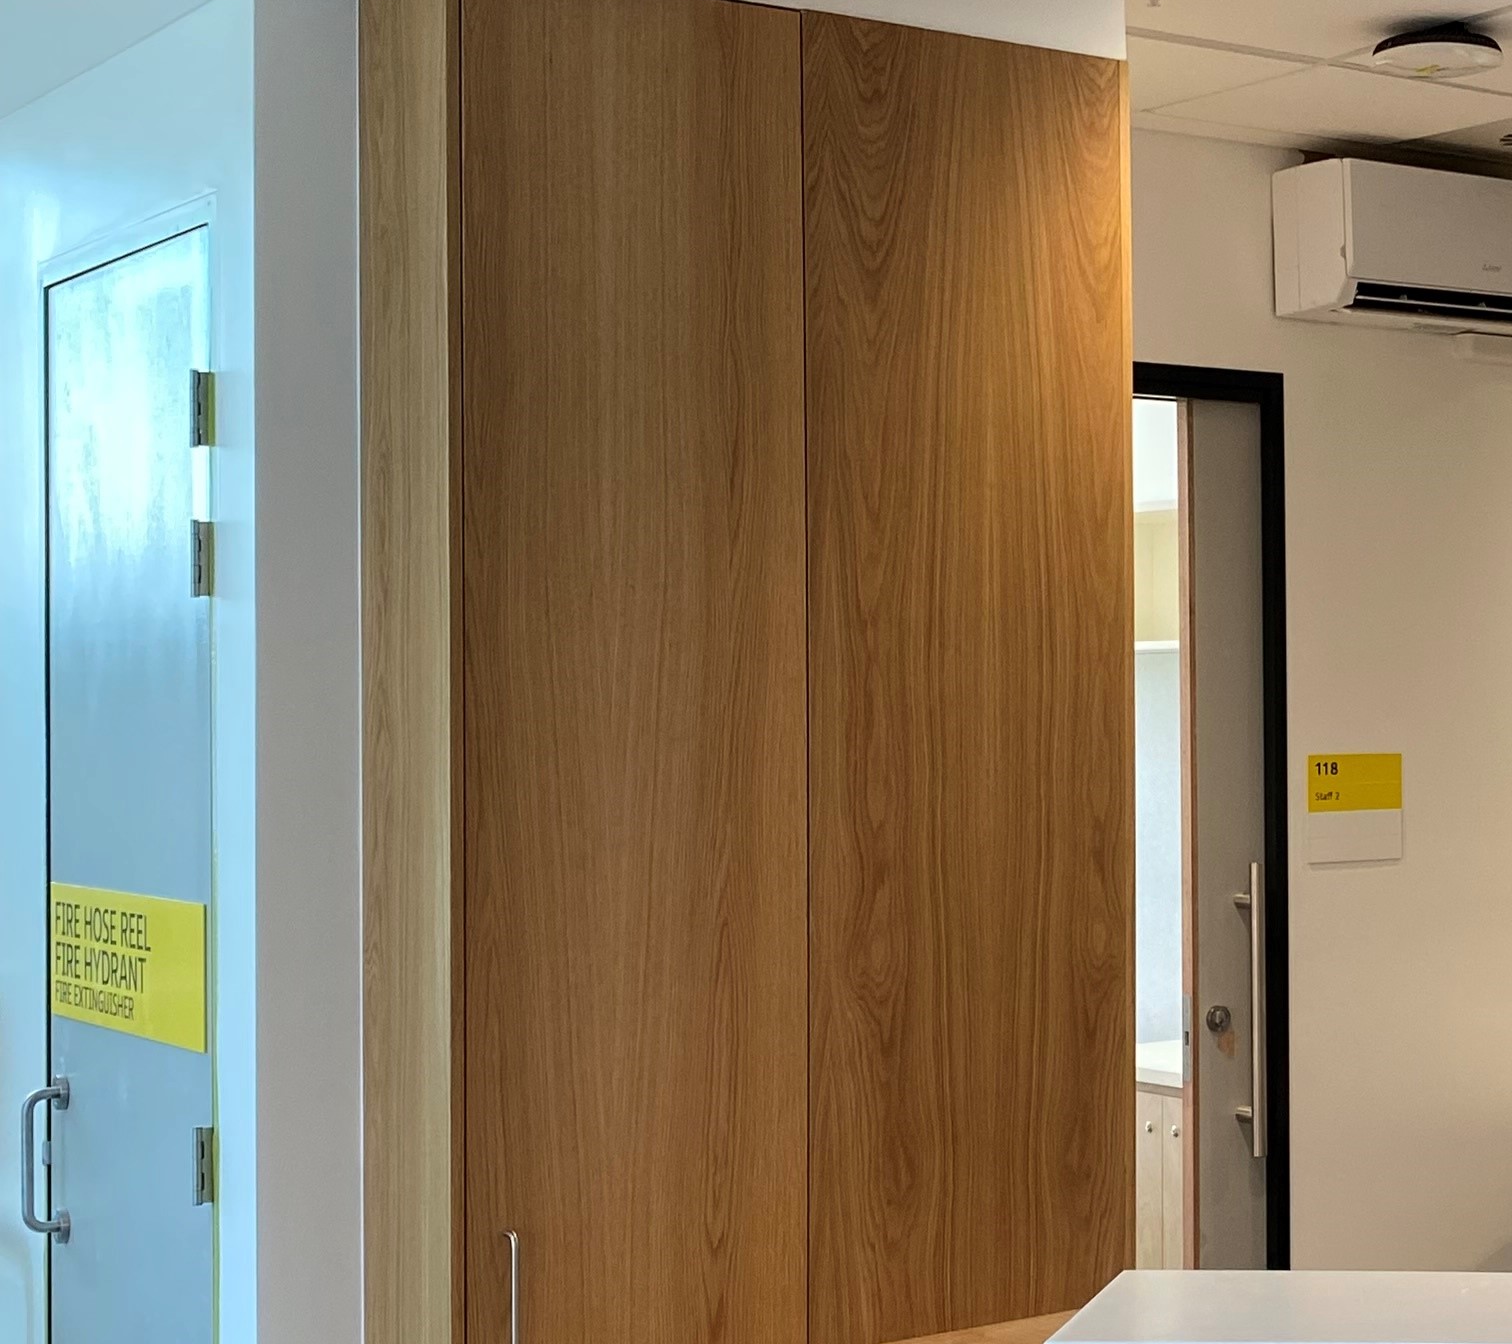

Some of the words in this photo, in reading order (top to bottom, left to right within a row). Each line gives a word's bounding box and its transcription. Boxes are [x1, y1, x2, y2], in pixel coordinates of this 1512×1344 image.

[1315, 761, 1338, 775] 118
[1315, 791, 1332, 801] Staff
[55, 902, 81, 938] FIRE
[84, 907, 117, 945] HOSE
[121, 912, 151, 952] REEL
[55, 942, 81, 979] FIRE
[84, 947, 147, 994] HYDRANT
[55, 980, 72, 1005] FIRE
[74, 982, 135, 1021] EXTINGUISHER
